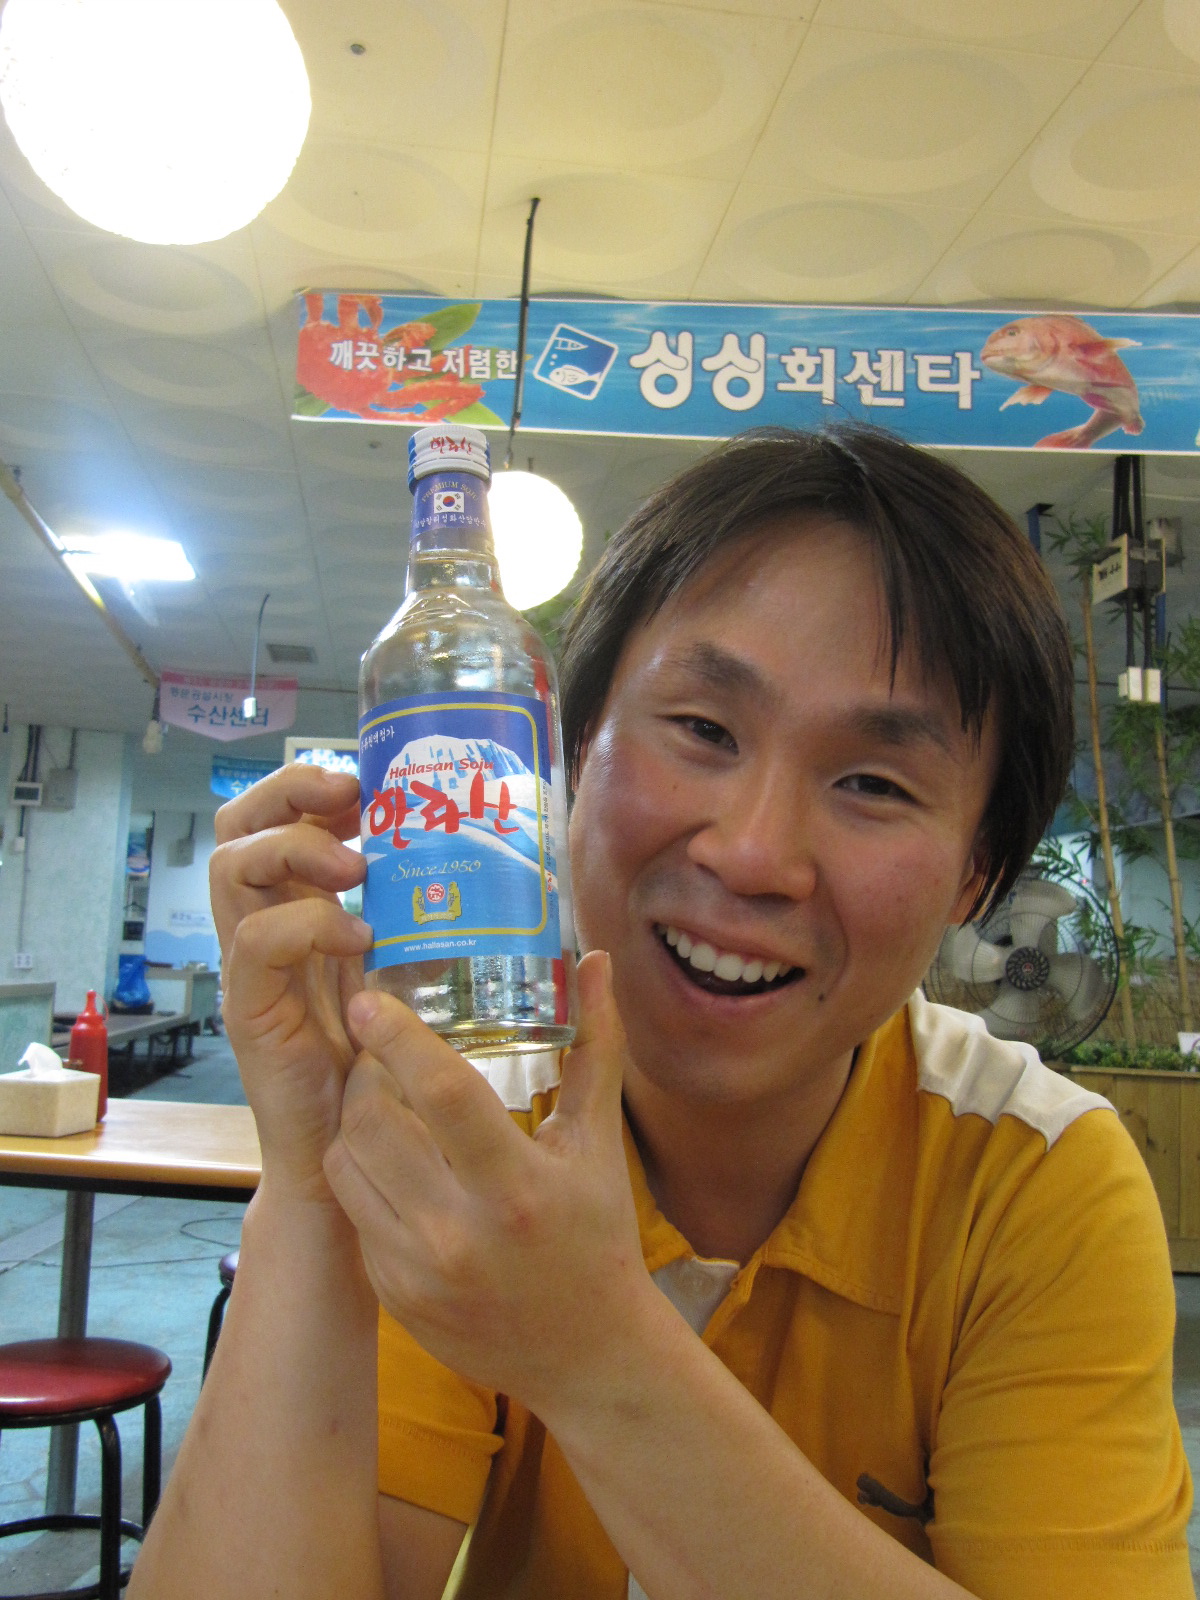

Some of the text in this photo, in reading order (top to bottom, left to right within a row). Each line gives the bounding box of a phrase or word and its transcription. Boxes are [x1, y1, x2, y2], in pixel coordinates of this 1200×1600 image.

[329, 340, 517, 380] 깨끗하고 저렴한
[389, 757, 494, 780] Hallasan Soju
[368, 771, 519, 849] 한라산
[391, 859, 482, 881] Since 1950
[403, 939, 477, 952] www.hallasan.co.kr
